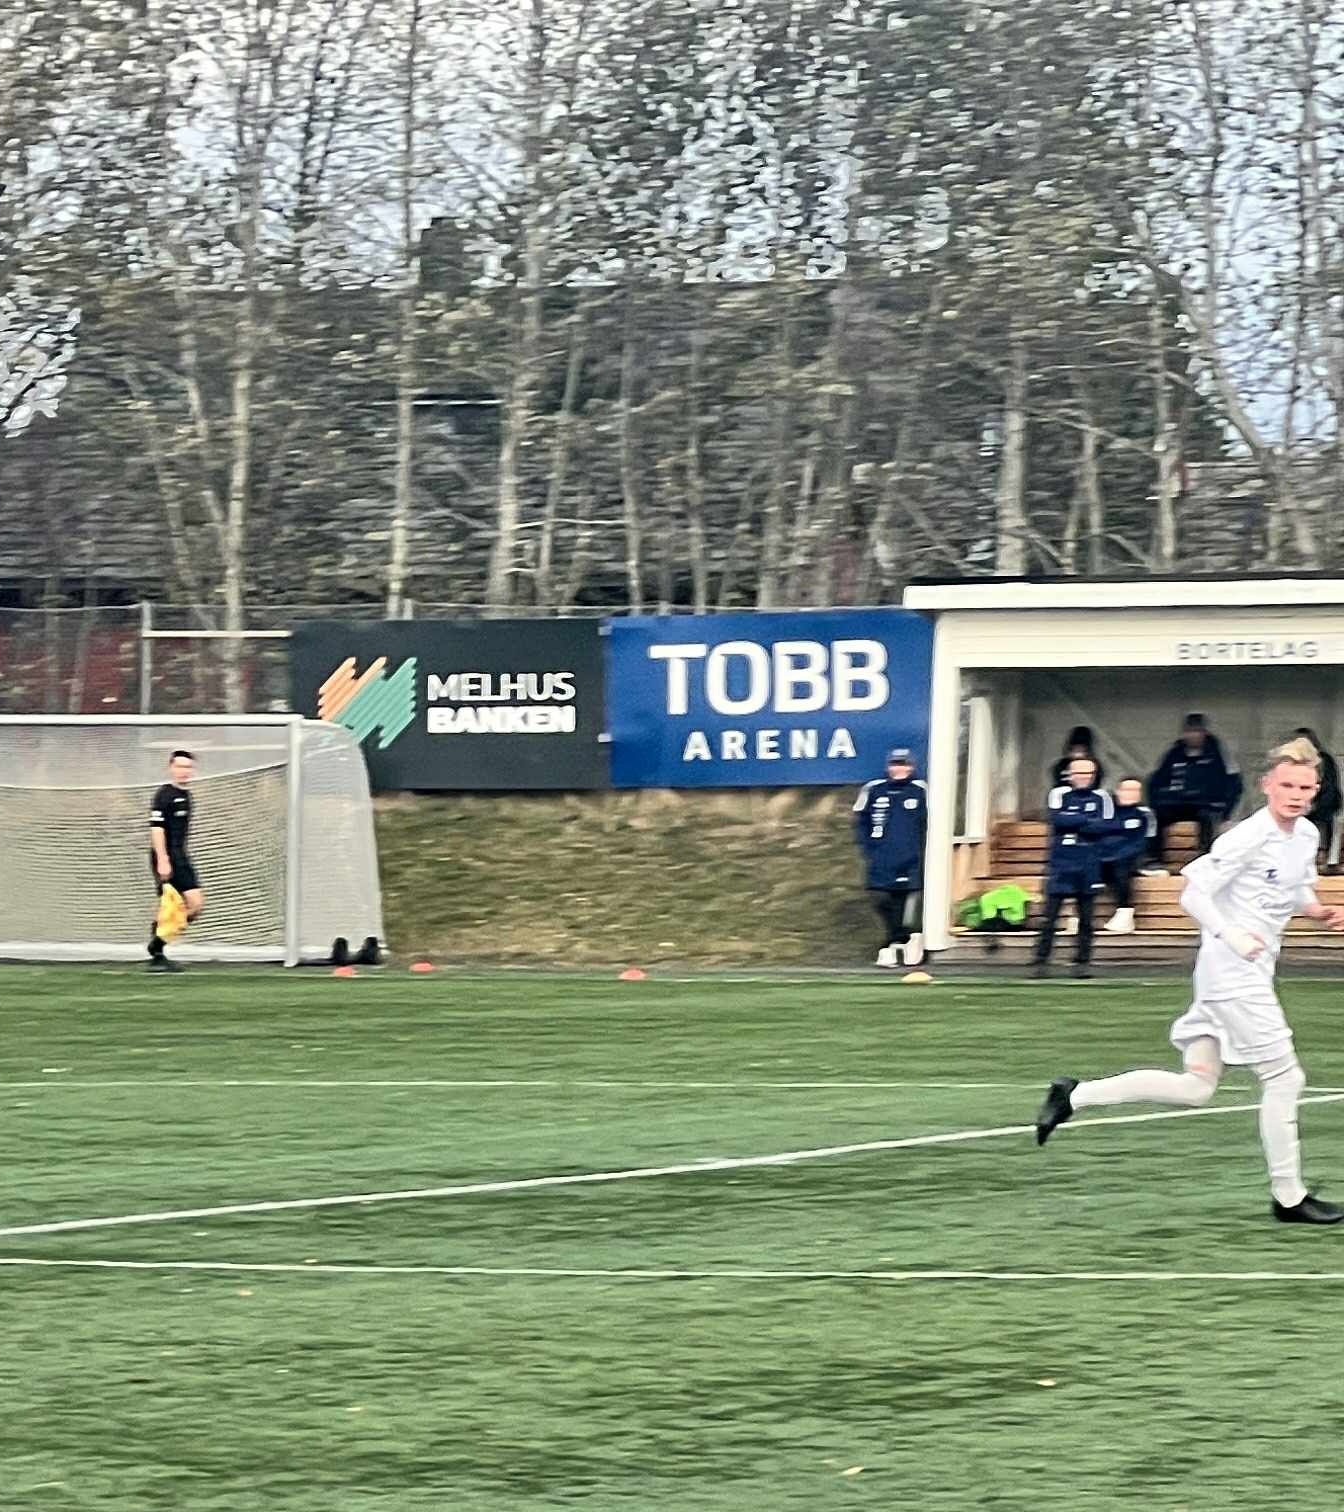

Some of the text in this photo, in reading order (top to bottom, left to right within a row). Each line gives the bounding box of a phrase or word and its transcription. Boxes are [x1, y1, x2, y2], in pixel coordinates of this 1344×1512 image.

[1176, 641, 1319, 660] BORTELAG
[428, 671, 576, 701] MELHUS
[648, 639, 890, 716] TOBB
[428, 705, 576, 733] BANKEN
[682, 727, 857, 762] ARENA
